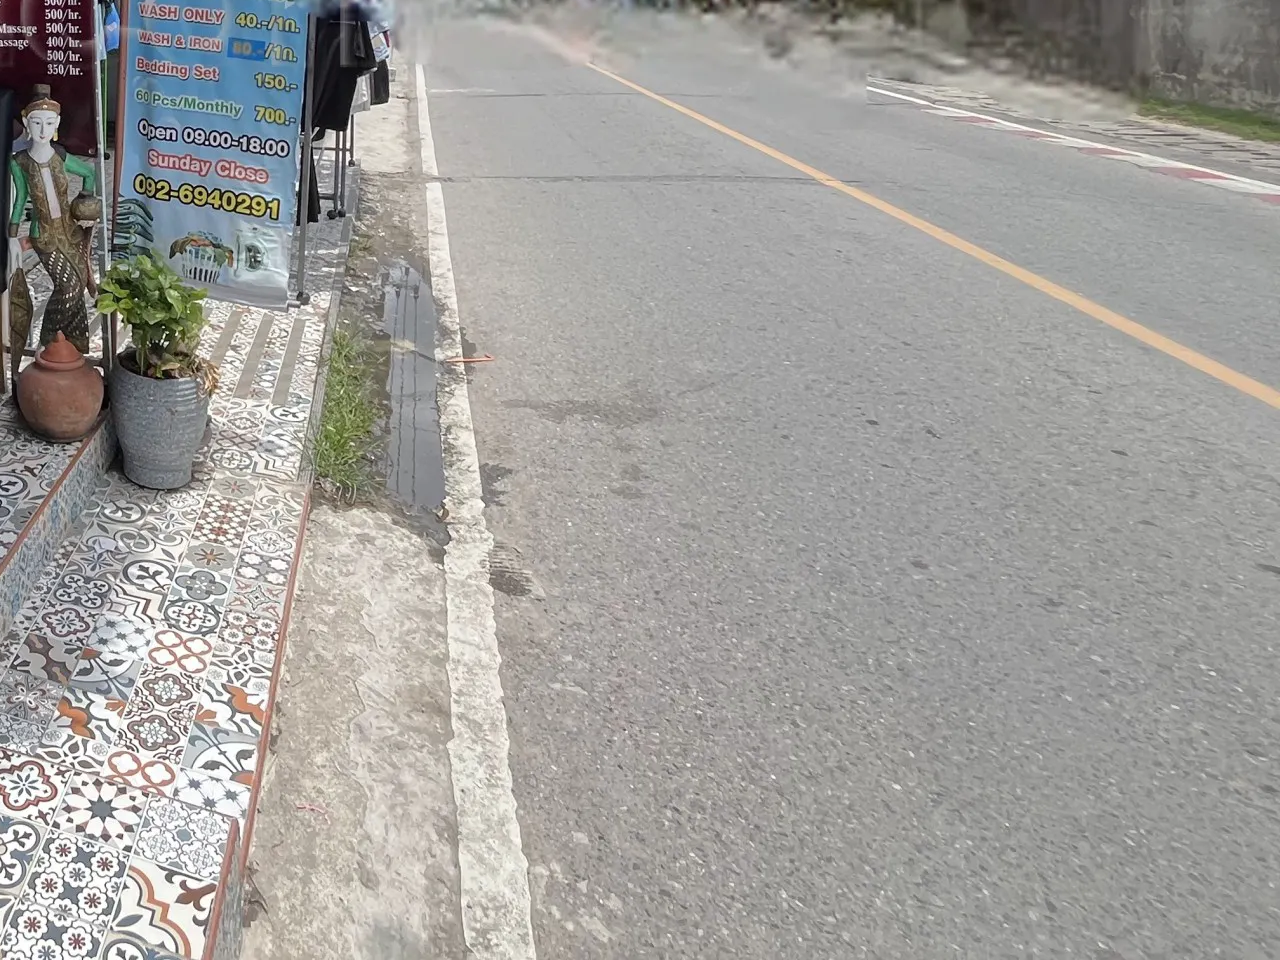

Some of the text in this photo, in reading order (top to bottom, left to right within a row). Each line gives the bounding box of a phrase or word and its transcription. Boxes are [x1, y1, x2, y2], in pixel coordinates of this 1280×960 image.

[45, 8, 81, 21] 500/hr.
[138, 2, 180, 18] WASH
[184, 9, 225, 25] ONLY
[45, 22, 82, 35] 500/hr.
[46, 36, 82, 49] 400/hr.
[138, 30, 171, 47] WASH
[175, 35, 185, 47] &
[189, 36, 222, 52] IRON
[47, 49, 83, 63] 500/hr.
[47, 63, 83, 76] 350/hr.
[136, 57, 299, 91] Bedding Set 150.-
[135, 89, 297, 126] 60 Pcs/Monthly 700.-
[138, 119, 290, 158] Open 09.00-18.00
[148, 149, 269, 184] Sunday Close
[133, 173, 281, 220] 092-6940291
